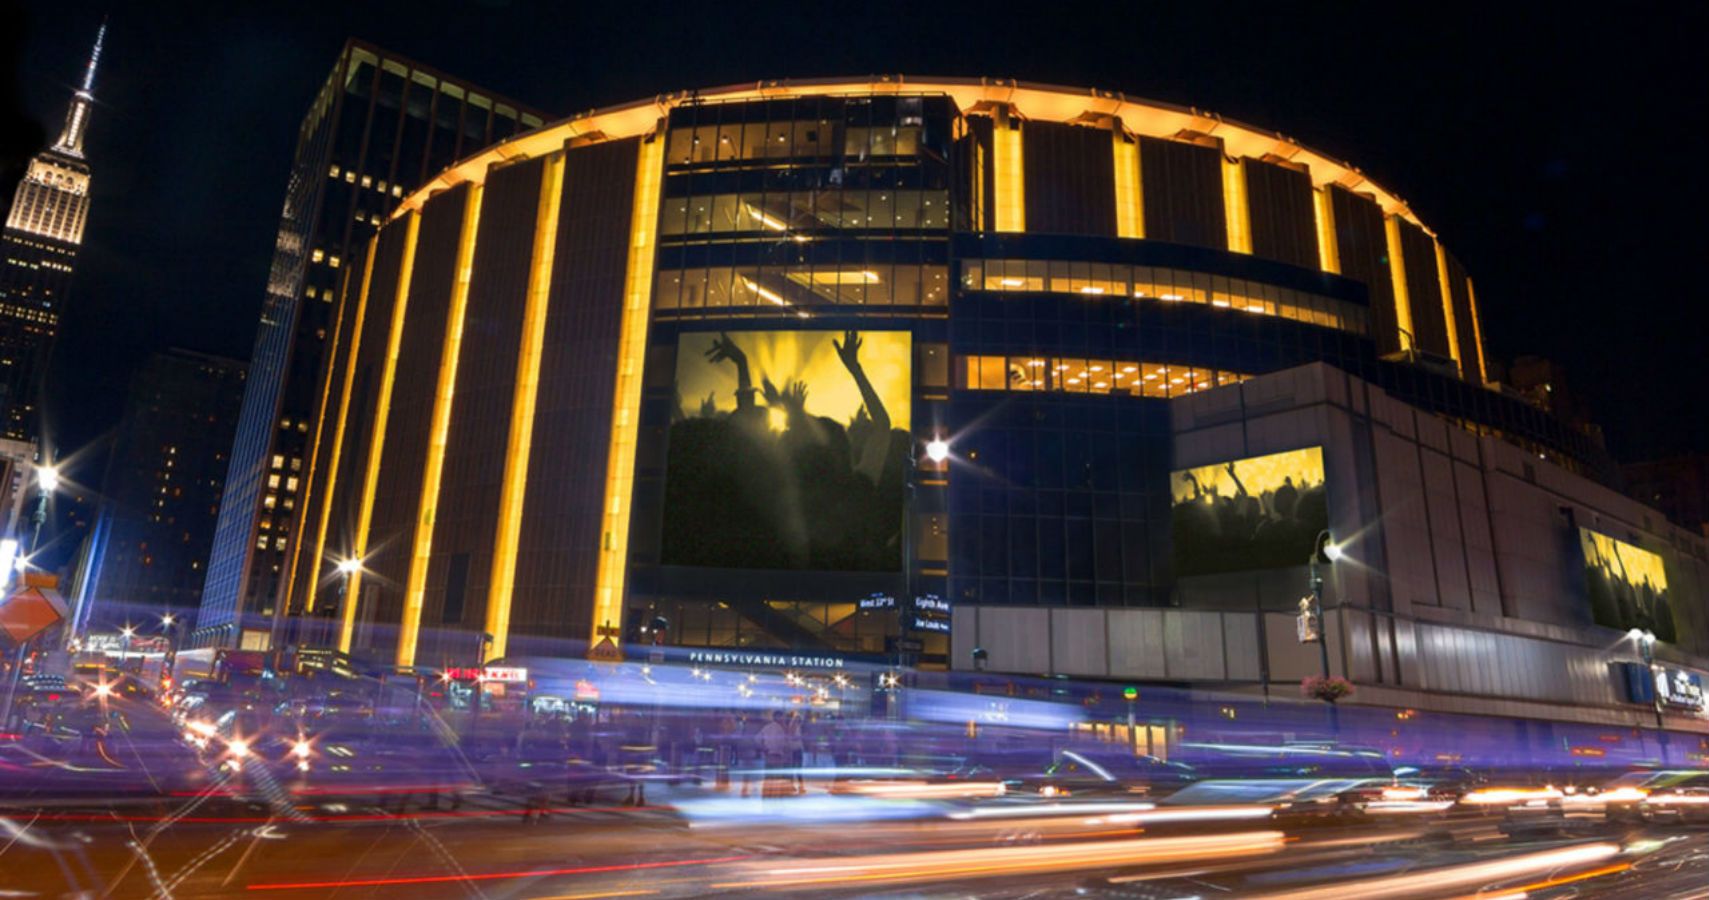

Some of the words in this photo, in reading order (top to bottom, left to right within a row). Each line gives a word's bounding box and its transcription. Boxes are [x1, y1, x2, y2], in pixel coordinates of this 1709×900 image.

[916, 597, 936, 609] Eighth
[937, 600, 949, 610] Ave
[690, 652, 786, 666] PENNSYLVANIA
[791, 656, 844, 668] STATION
